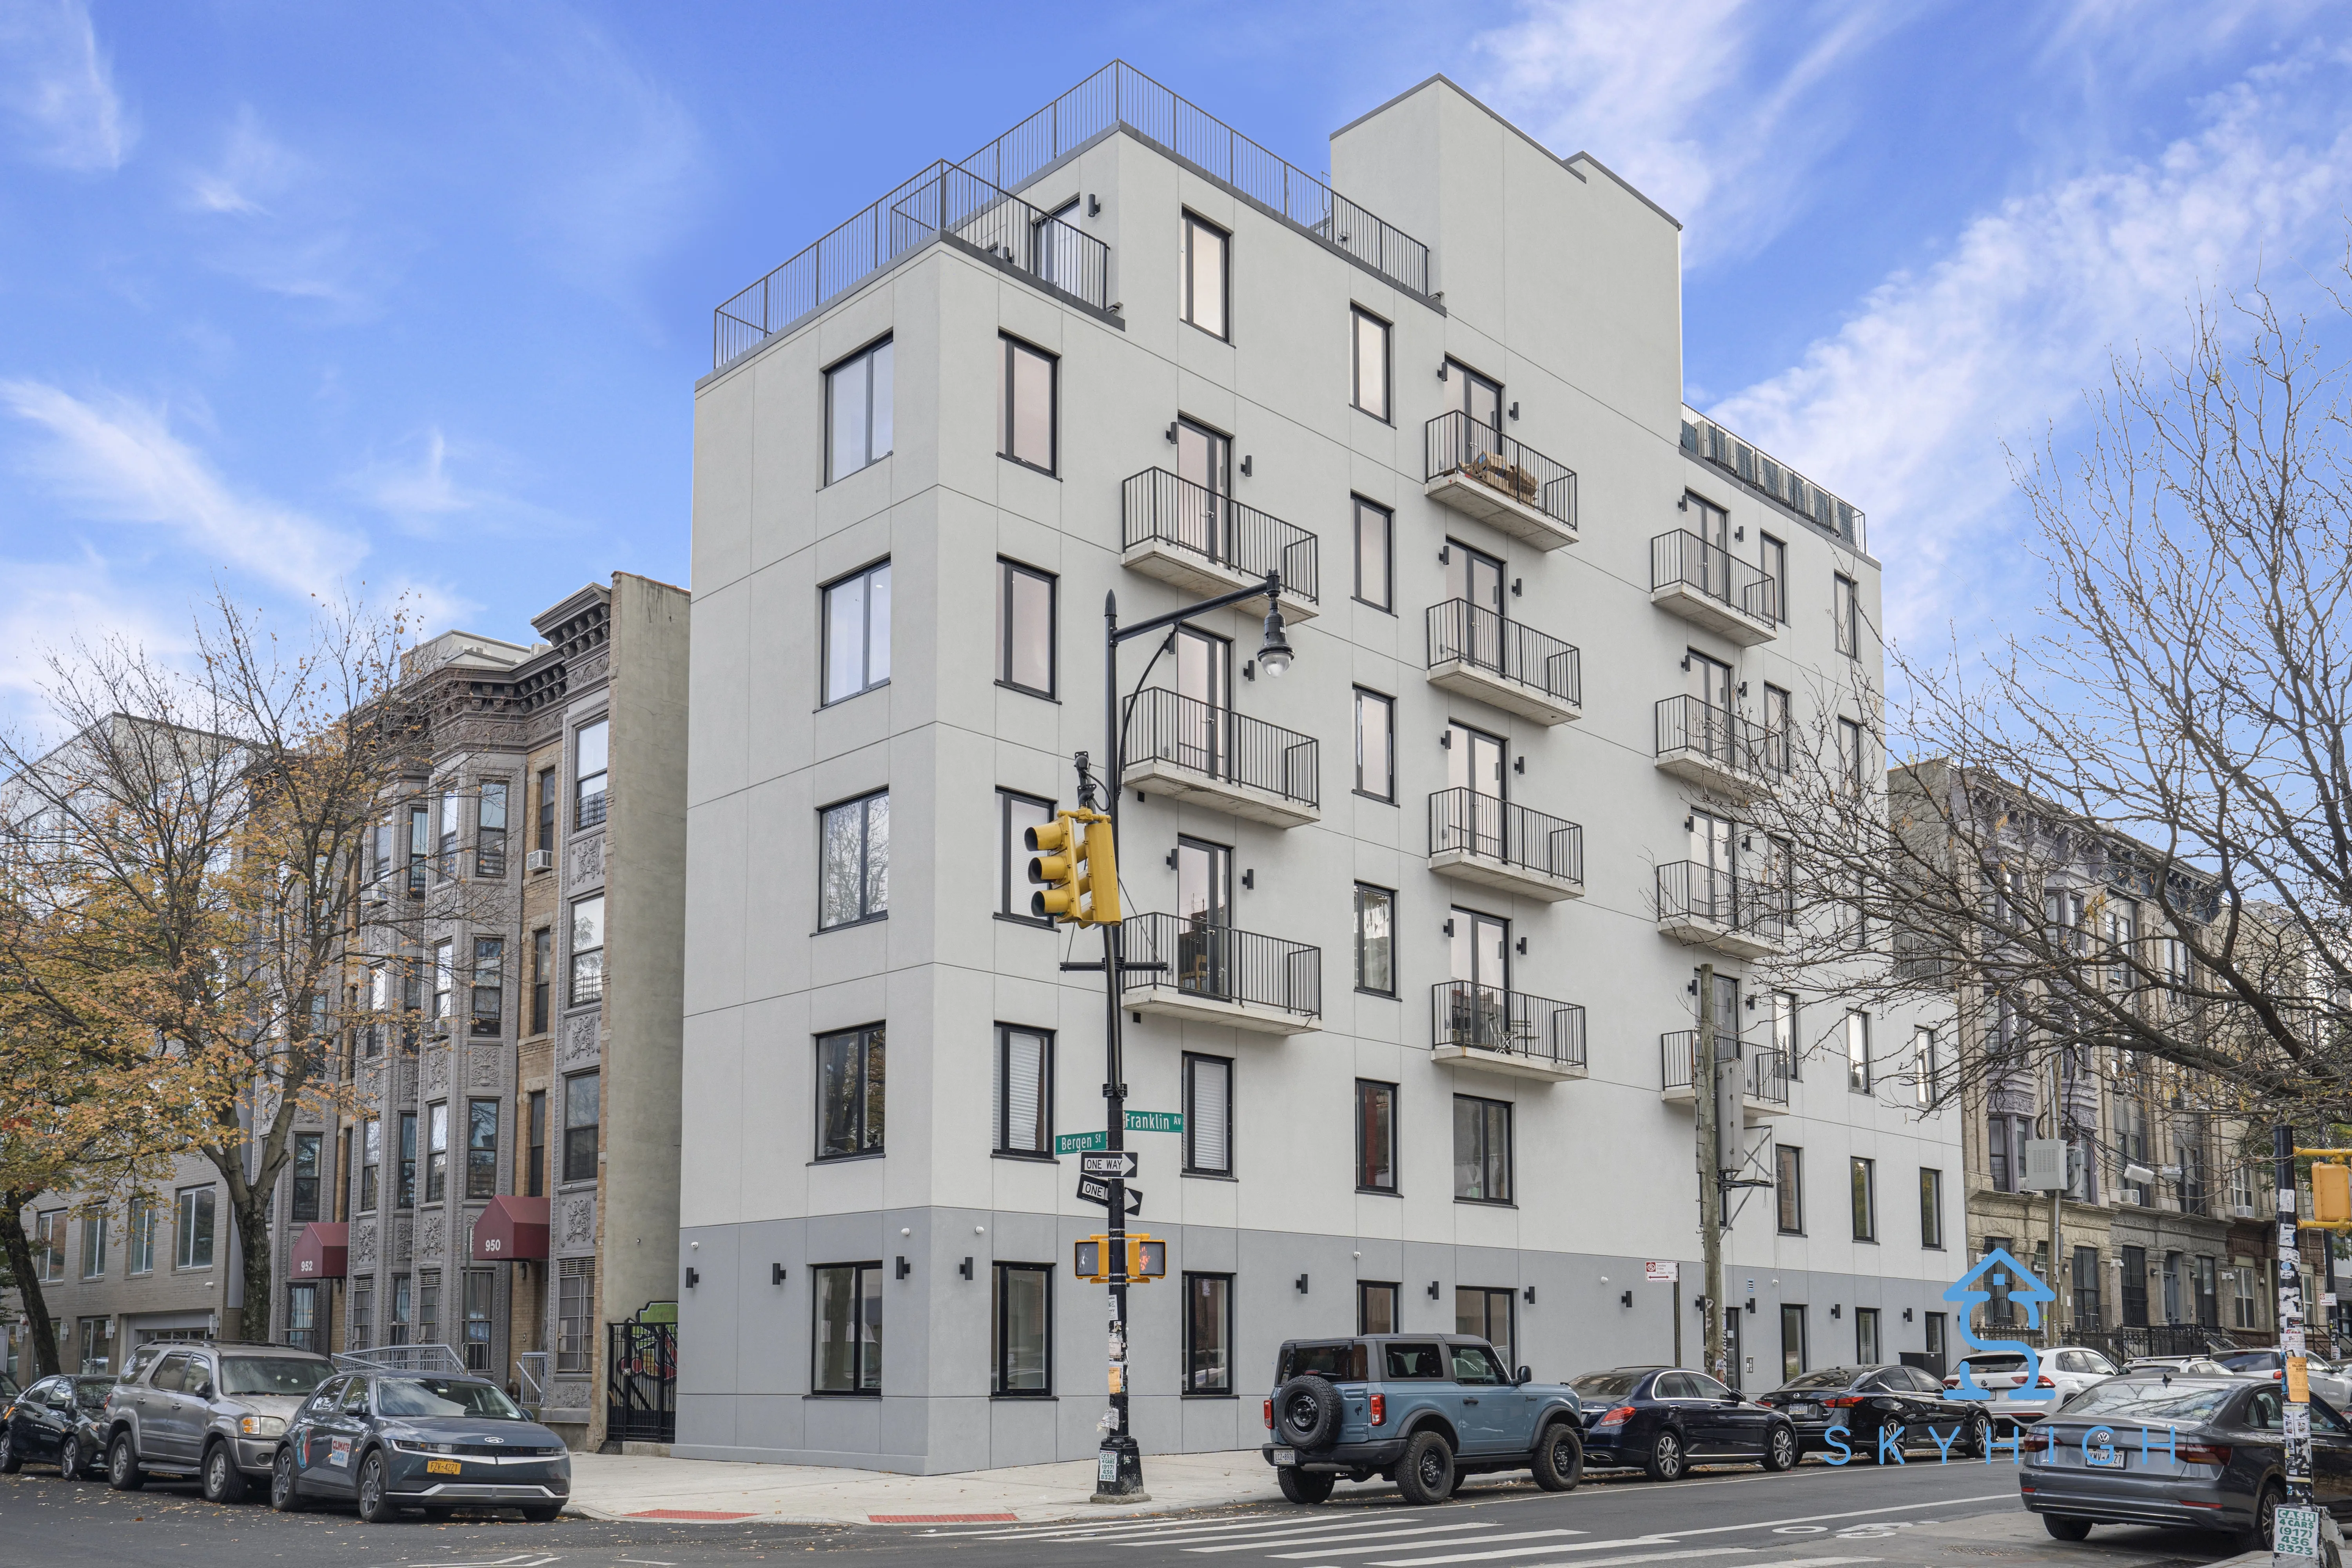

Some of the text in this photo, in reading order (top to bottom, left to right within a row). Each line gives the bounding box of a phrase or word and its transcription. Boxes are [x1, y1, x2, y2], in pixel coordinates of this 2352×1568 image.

[1125, 1113, 1181, 1129] Franklin Av
[1062, 1133, 1101, 1152] Bergen St
[1087, 1160, 1123, 1169] ONE WAY
[1085, 1183, 1103, 1197] ONE
[485, 1239, 501, 1252] 950
[301, 1260, 313, 1272] 952
[332, 1440, 350, 1453] CLIMATE
[332, 1450, 345, 1462] CLOCK
[2279, 1527, 2312, 1538] (917)
[2281, 1536, 2309, 1546] 436
[2277, 1543, 2313, 1555] 8323
